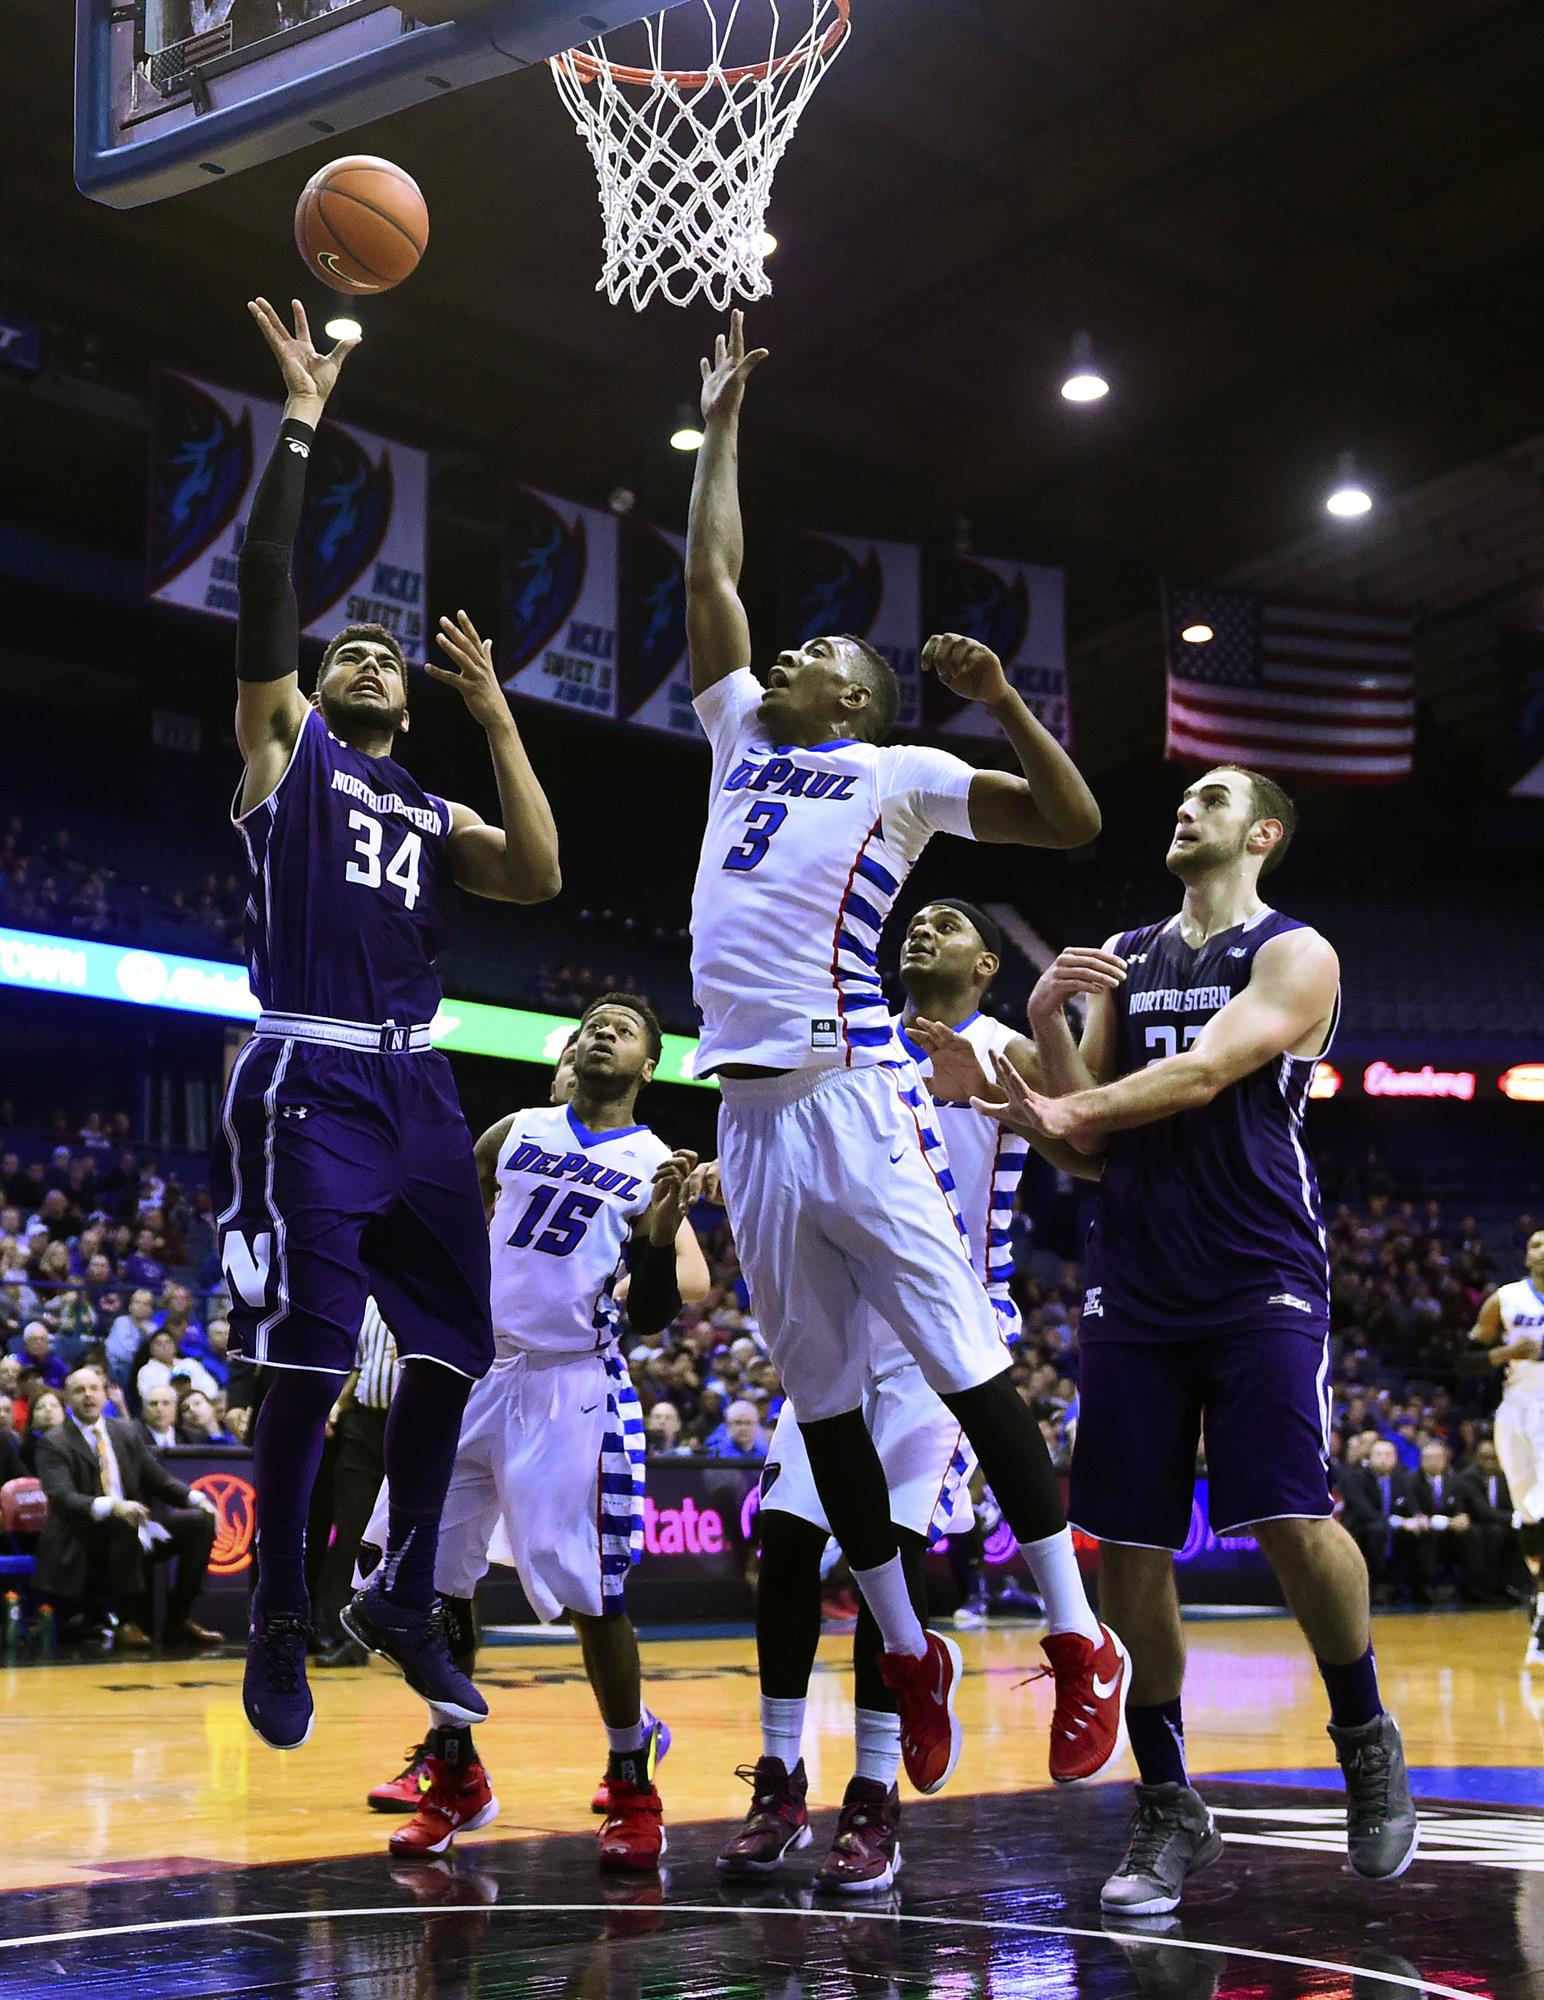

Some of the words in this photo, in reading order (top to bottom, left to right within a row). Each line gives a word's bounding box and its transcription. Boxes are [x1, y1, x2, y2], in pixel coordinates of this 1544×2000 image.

[345, 809, 423, 911] 34
[722, 800, 789, 871] 3
[391, 1030, 404, 1050] N
[506, 1183, 604, 1257] 15
[222, 1230, 271, 1308] N
